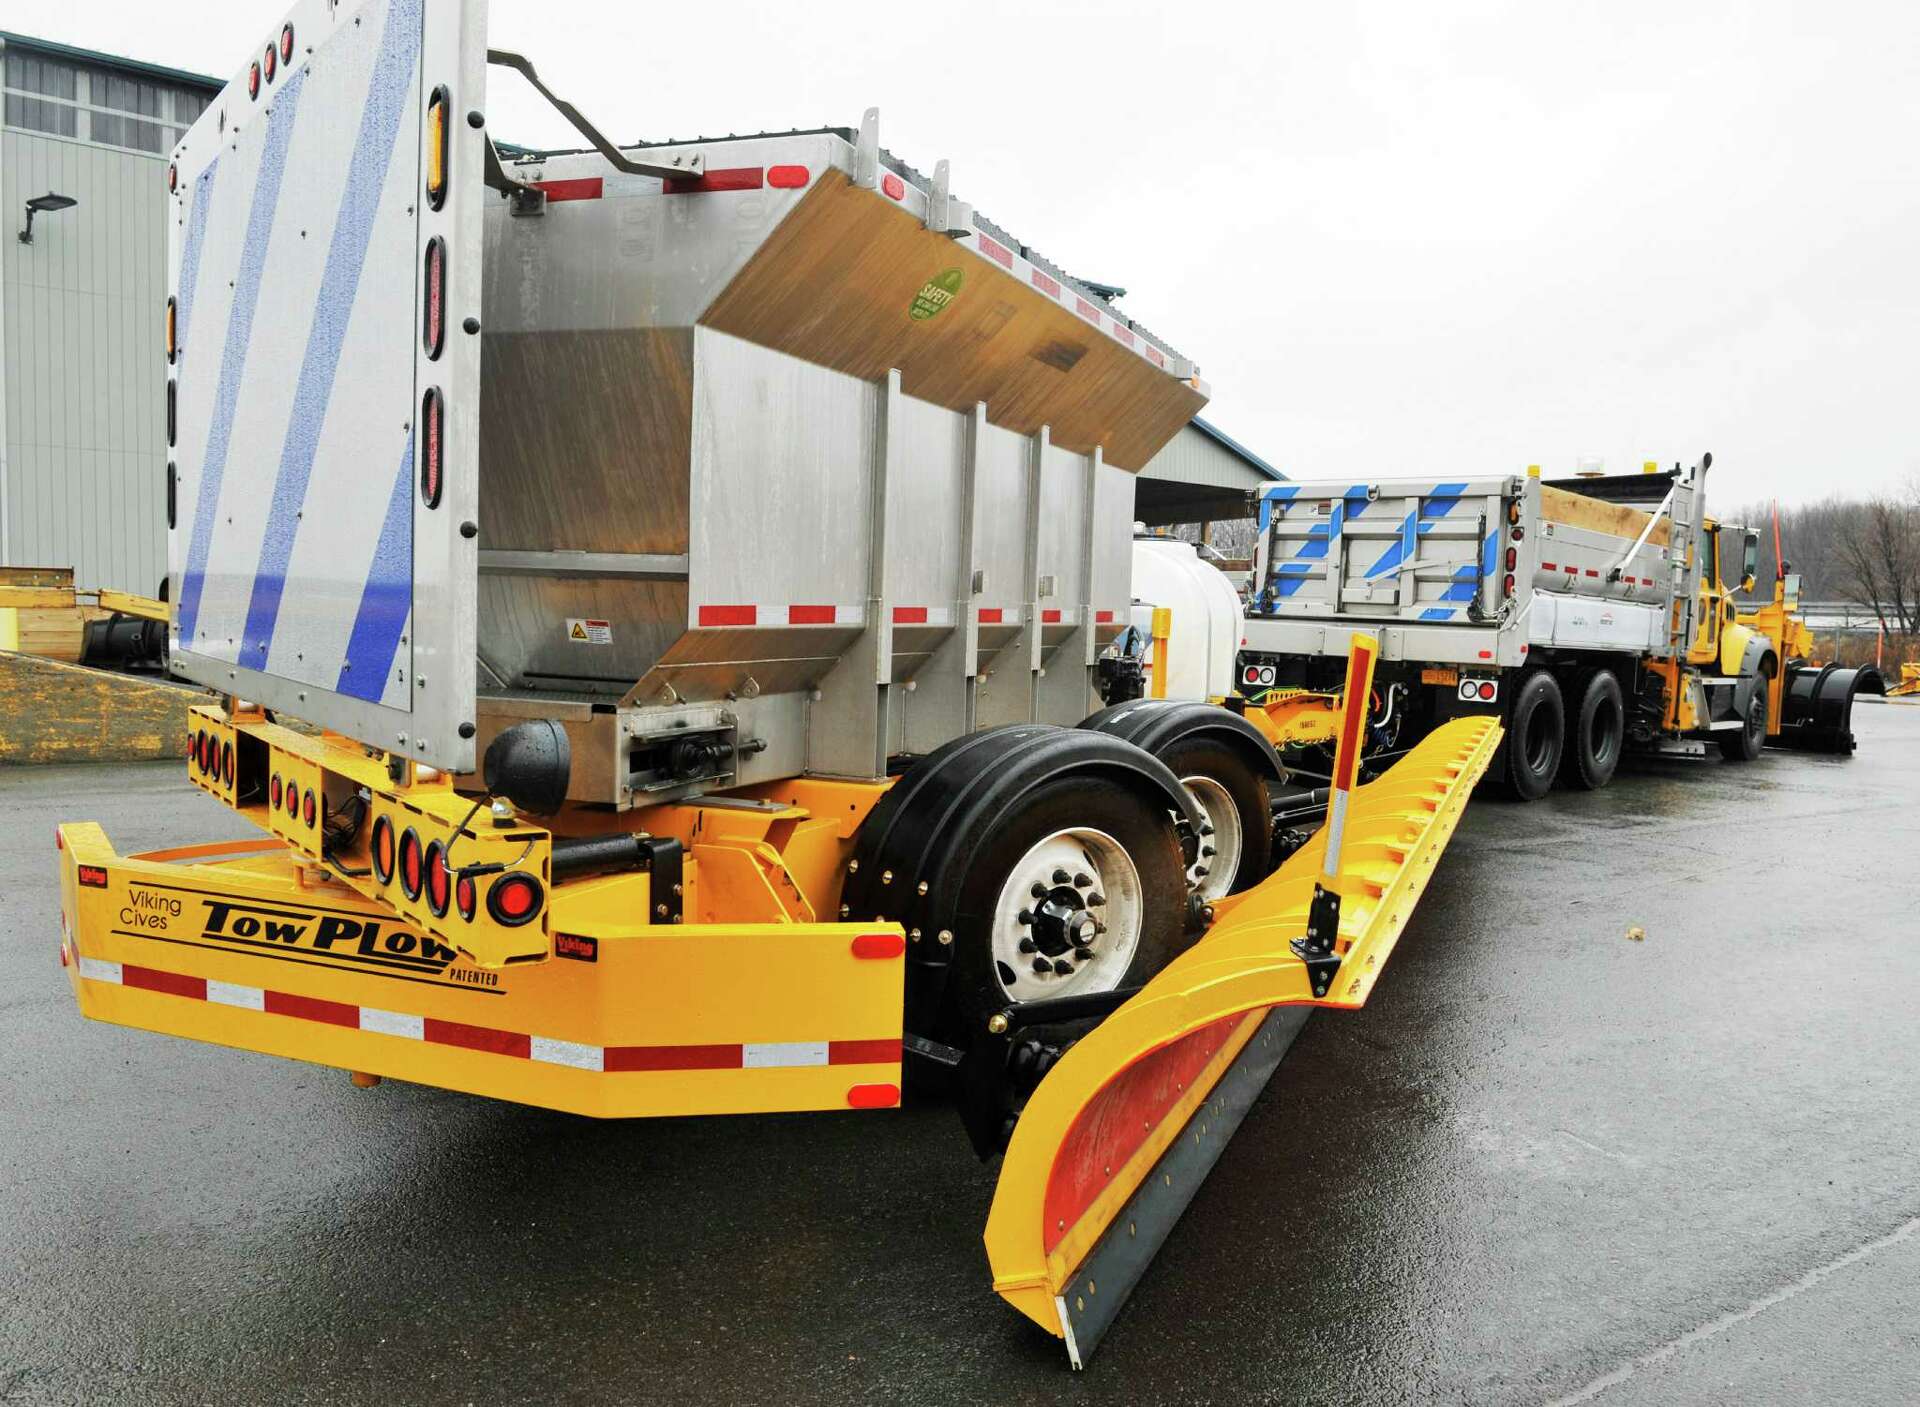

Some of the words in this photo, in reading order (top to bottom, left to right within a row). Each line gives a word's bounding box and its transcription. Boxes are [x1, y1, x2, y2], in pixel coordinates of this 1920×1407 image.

[919, 283, 954, 307] SAFETY
[128, 889, 182, 917] Viking
[119, 907, 168, 930] Cives
[450, 967, 498, 987] PATENTED
